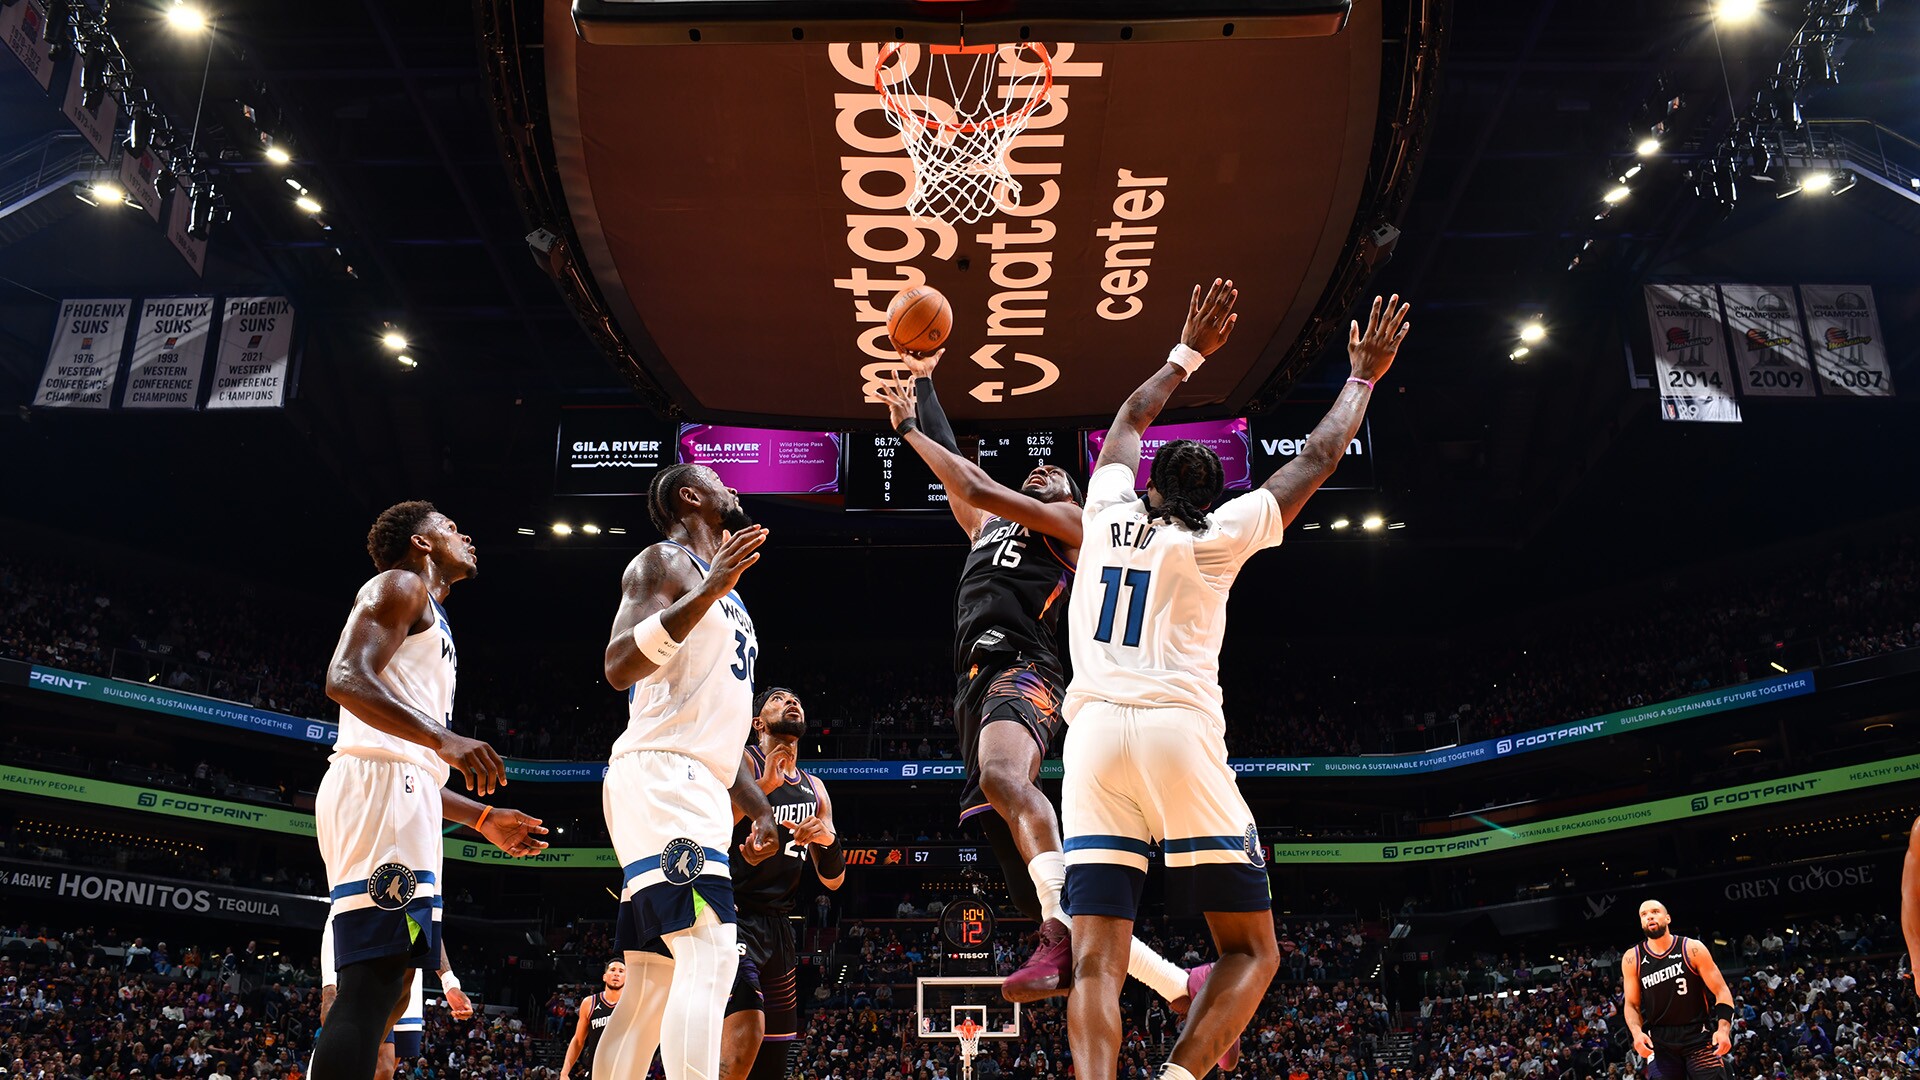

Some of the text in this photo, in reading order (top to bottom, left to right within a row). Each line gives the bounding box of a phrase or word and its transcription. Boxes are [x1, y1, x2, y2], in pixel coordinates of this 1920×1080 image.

[966, 42, 1103, 336] matchup
[1096, 168, 1169, 320] center
[63, 303, 127, 318] PHOENIX
[145, 303, 208, 317] PHOENIX
[230, 301, 289, 315] PHOENIX
[1656, 310, 1712, 319] CHAMPIONS
[1735, 310, 1790, 319] CHAMPIONS
[1814, 310, 1870, 318] CHAMPIONS
[71, 320, 109, 334] SUNS
[154, 319, 192, 334] SUNS
[239, 318, 275, 332] SUNS
[73, 353, 94, 364] 1976
[157, 353, 179, 364] 1993
[241, 352, 263, 362] 2021
[58, 366, 103, 376] WESTERN
[143, 366, 188, 376] WESTERN
[229, 365, 271, 375] WESTERN
[46, 378, 107, 390] CONFERENCE
[132, 379, 193, 390] CONFERENCE
[218, 377, 278, 388] CONFERENCE
[1668, 370, 1723, 389] 2014
[1749, 370, 1804, 388] 2009
[1829, 370, 1883, 388] 2007
[45, 391, 102, 403] CHAMPIONS
[132, 392, 188, 403] CHAMPIONS
[219, 390, 273, 401] CHAMPIONS
[572, 441, 659, 452] GILA RIVER
[695, 443, 760, 452] GILA RIVER
[874, 437, 901, 447] 66.7%
[1026, 436, 1055, 446] 62.5%
[1140, 440, 1167, 448] IVER
[1260, 434, 1362, 456] vern
[877, 448, 895, 458] 21/3
[1028, 447, 1051, 456] 22/10
[883, 459, 892, 468] 18
[1038, 459, 1044, 467] 8
[883, 470, 892, 479] 13
[885, 481, 890, 491] 9
[928, 483, 944, 491] POIN
[884, 492, 890, 502] 5
[1110, 522, 1156, 550] REID
[992, 539, 1027, 569] 15
[1093, 566, 1151, 648] 11
[30, 671, 293, 731] PRINT BUILDING A SUSTAINABLE FUTURE TOGETHER
[1620, 679, 1806, 725] BUILDING A SUSTAINABLE FUTURE TOGETHER
[1516, 721, 1604, 749] FOOTPRINT
[1325, 763, 1359, 771] BUILDING
[1368, 761, 1417, 771] SUSTAINABLE
[1419, 756, 1448, 767] FUTURE
[1448, 748, 1485, 762] TOGETHER
[520, 768, 550, 776] FUTURE
[1849, 762, 1920, 781] HEALTHY PLAN
[2, 773, 47, 789] HEALTHY
[162, 798, 264, 822] FOOTPRINT
[1713, 779, 1818, 806] FOOTPRINT
[771, 801, 816, 826] HOENIX
[1512, 809, 1652, 840] SUSTAINABLE PACKAGING SOLUTIONS
[1277, 849, 1310, 858] HEALTHY
[1403, 837, 1489, 856] FOOTPRINT
[596, 854, 619, 862] HEAL
[842, 849, 978, 865] UNS 57 1:04
[1724, 864, 1873, 901] GREY GOOSE
[11, 872, 52, 889] AGAVE
[58, 873, 211, 913] HORNITOS
[217, 897, 280, 917] TEQUILA
[963, 909, 984, 921] 1:04
[962, 921, 982, 943] 12
[1641, 962, 1684, 990] PHOENIX
[1675, 977, 1688, 996] 3
